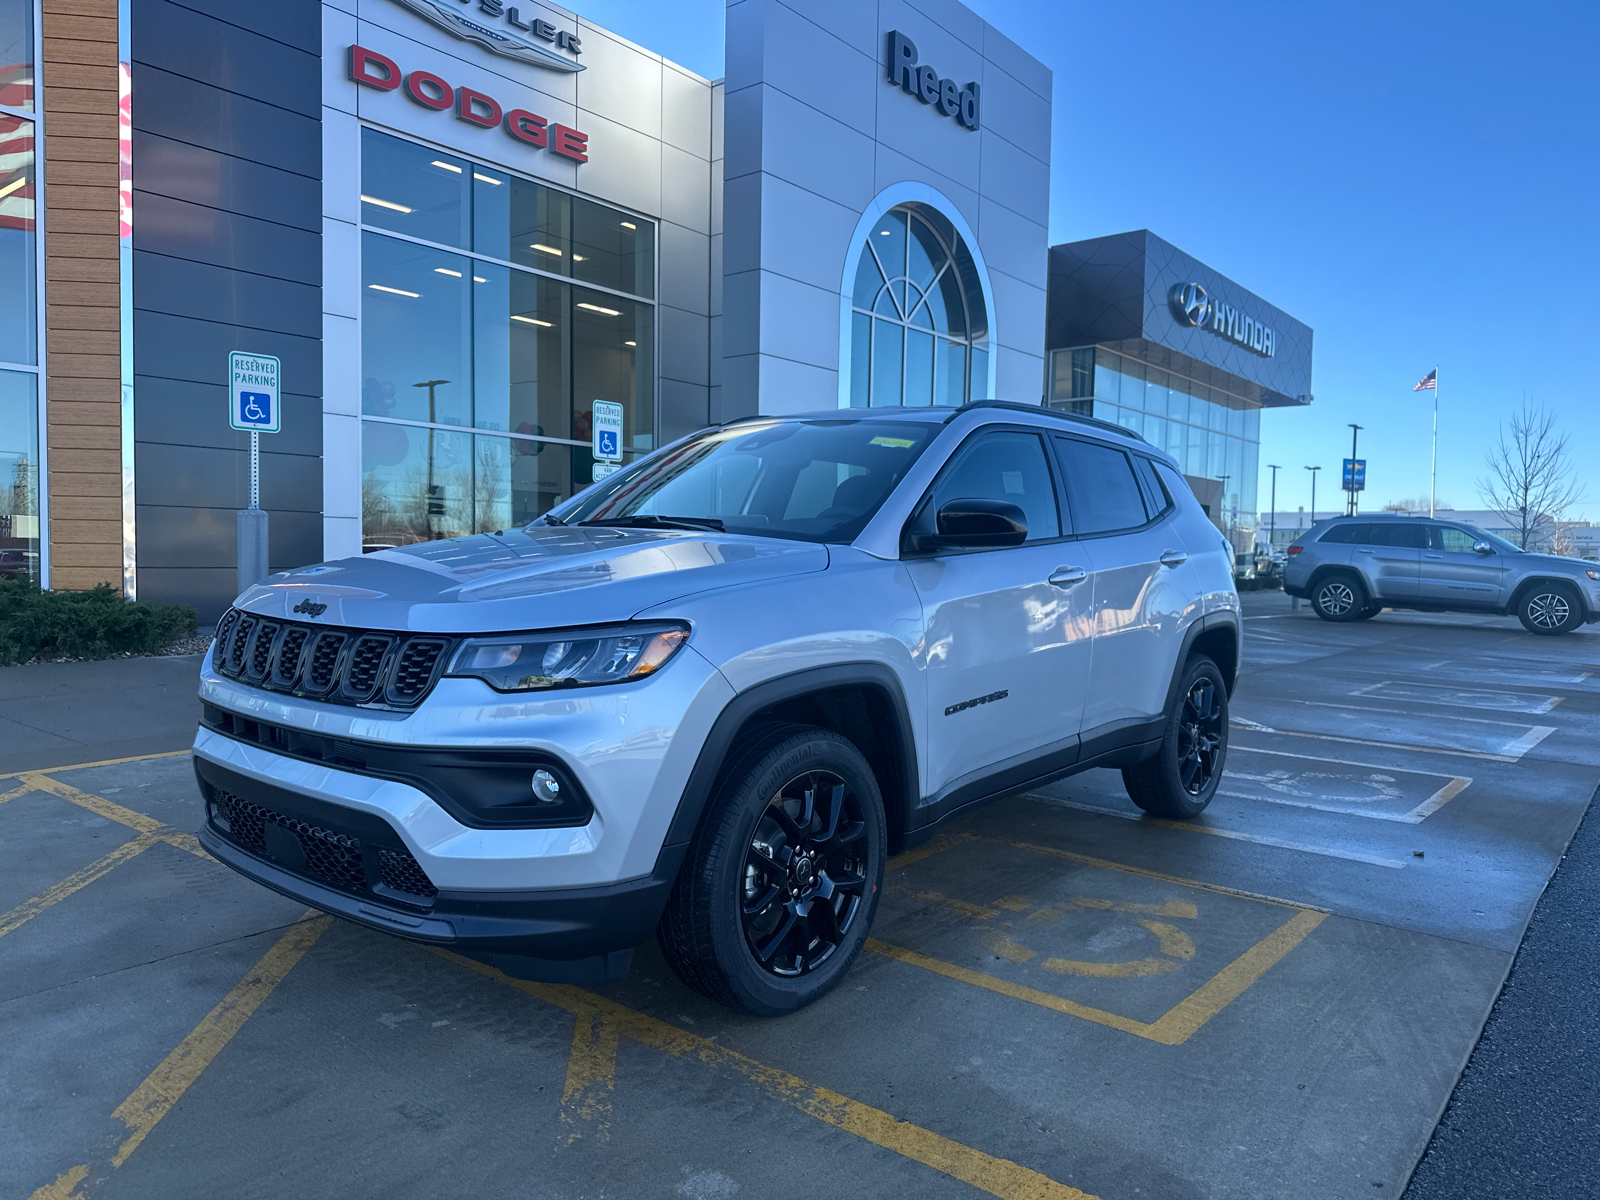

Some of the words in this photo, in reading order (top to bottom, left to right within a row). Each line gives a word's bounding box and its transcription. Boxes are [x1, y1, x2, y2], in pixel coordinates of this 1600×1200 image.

[458, 18, 503, 41] CHRYSLER
[459, 0, 582, 54] SLER
[887, 29, 981, 132] Reed
[347, 44, 588, 163] DODGE
[1213, 299, 1276, 358] HYUNDAI
[234, 359, 275, 374] RESERVED
[234, 372, 276, 387] PARKING
[595, 416, 620, 427] PARKING
[596, 406, 620, 417] RESERVED
[292, 597, 328, 619] Jeep
[944, 689, 1009, 716] COMPASS
[757, 745, 812, 800] Continental
